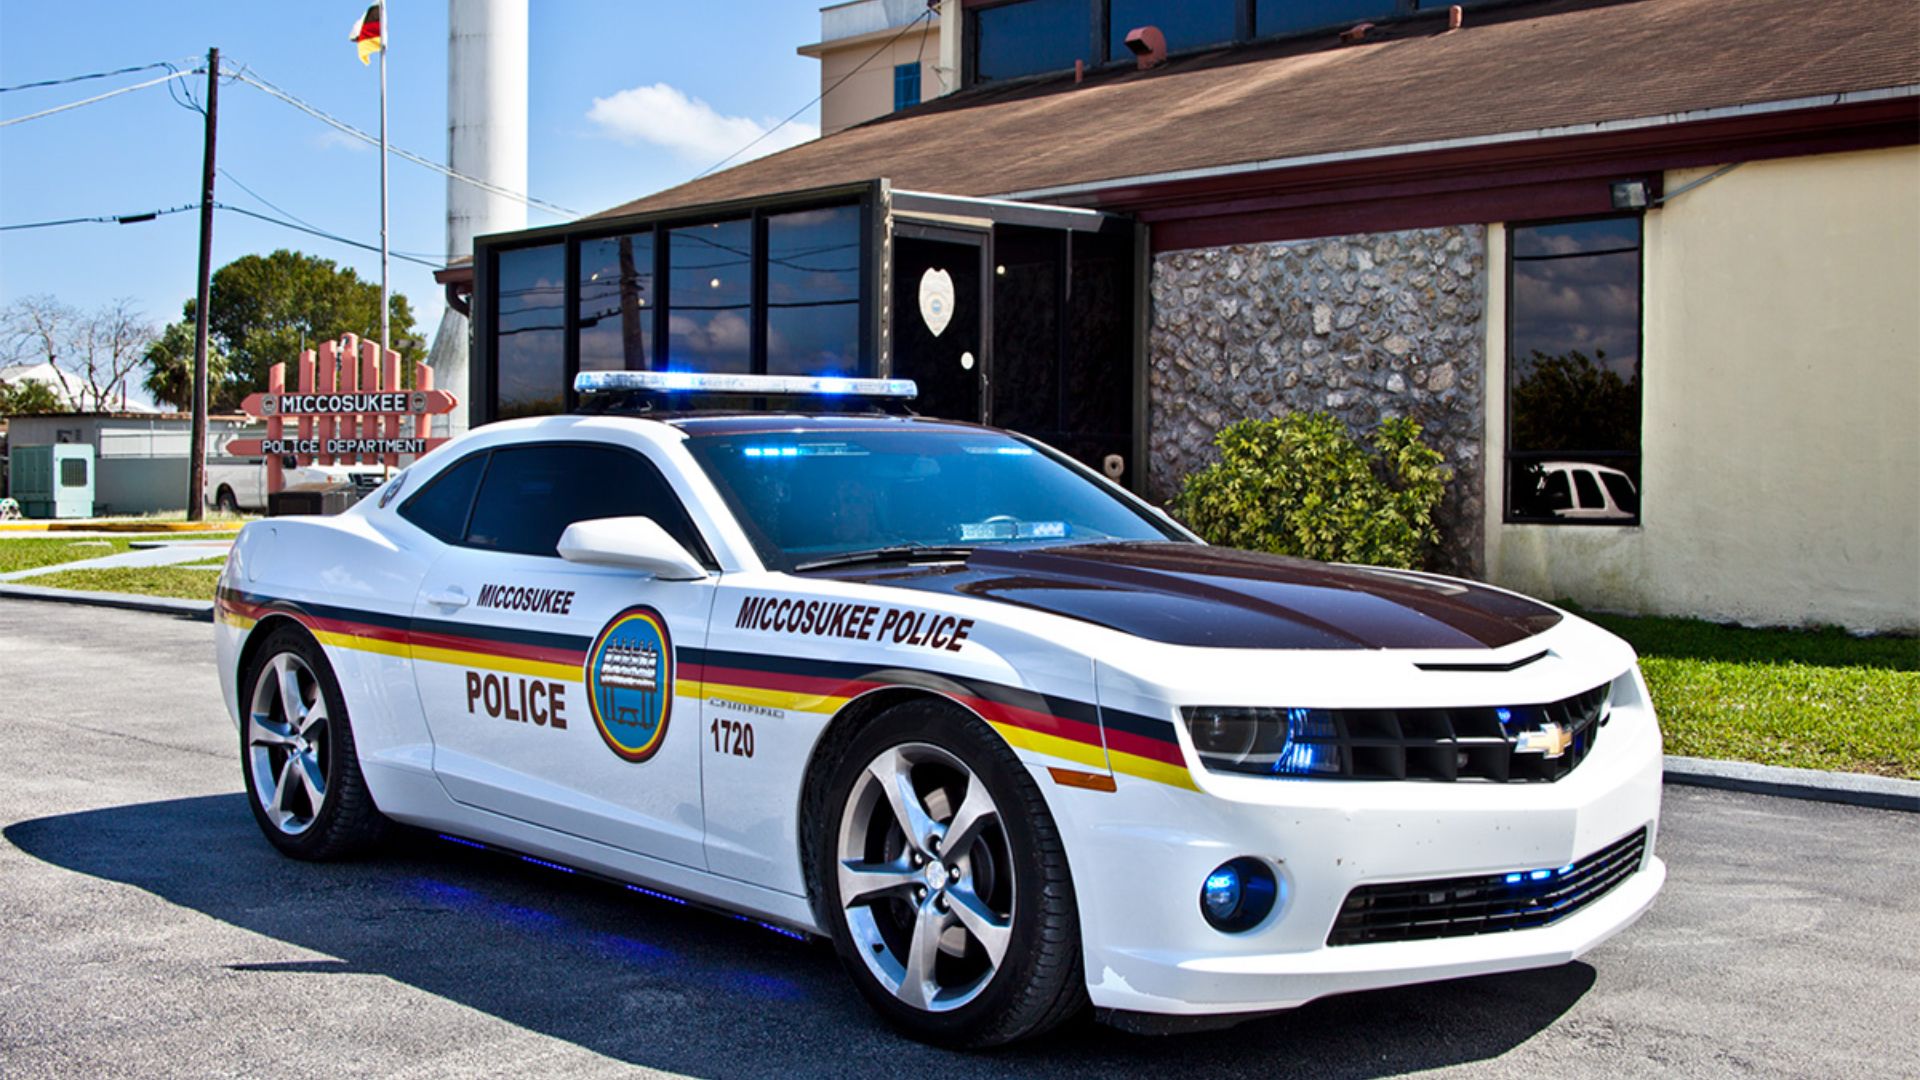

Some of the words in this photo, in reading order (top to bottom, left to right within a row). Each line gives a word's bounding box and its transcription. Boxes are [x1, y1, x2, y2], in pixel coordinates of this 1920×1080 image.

[281, 394, 406, 412] MICCOSUKEE
[262, 439, 320, 454] POLICE
[327, 439, 425, 453] DEPARTMENT
[477, 584, 575, 615] MICCOSUKEE
[735, 596, 880, 641] MICCOSUKEE
[876, 608, 974, 652] POLICE
[466, 671, 568, 730] POLICE
[710, 717, 755, 758] 1720
